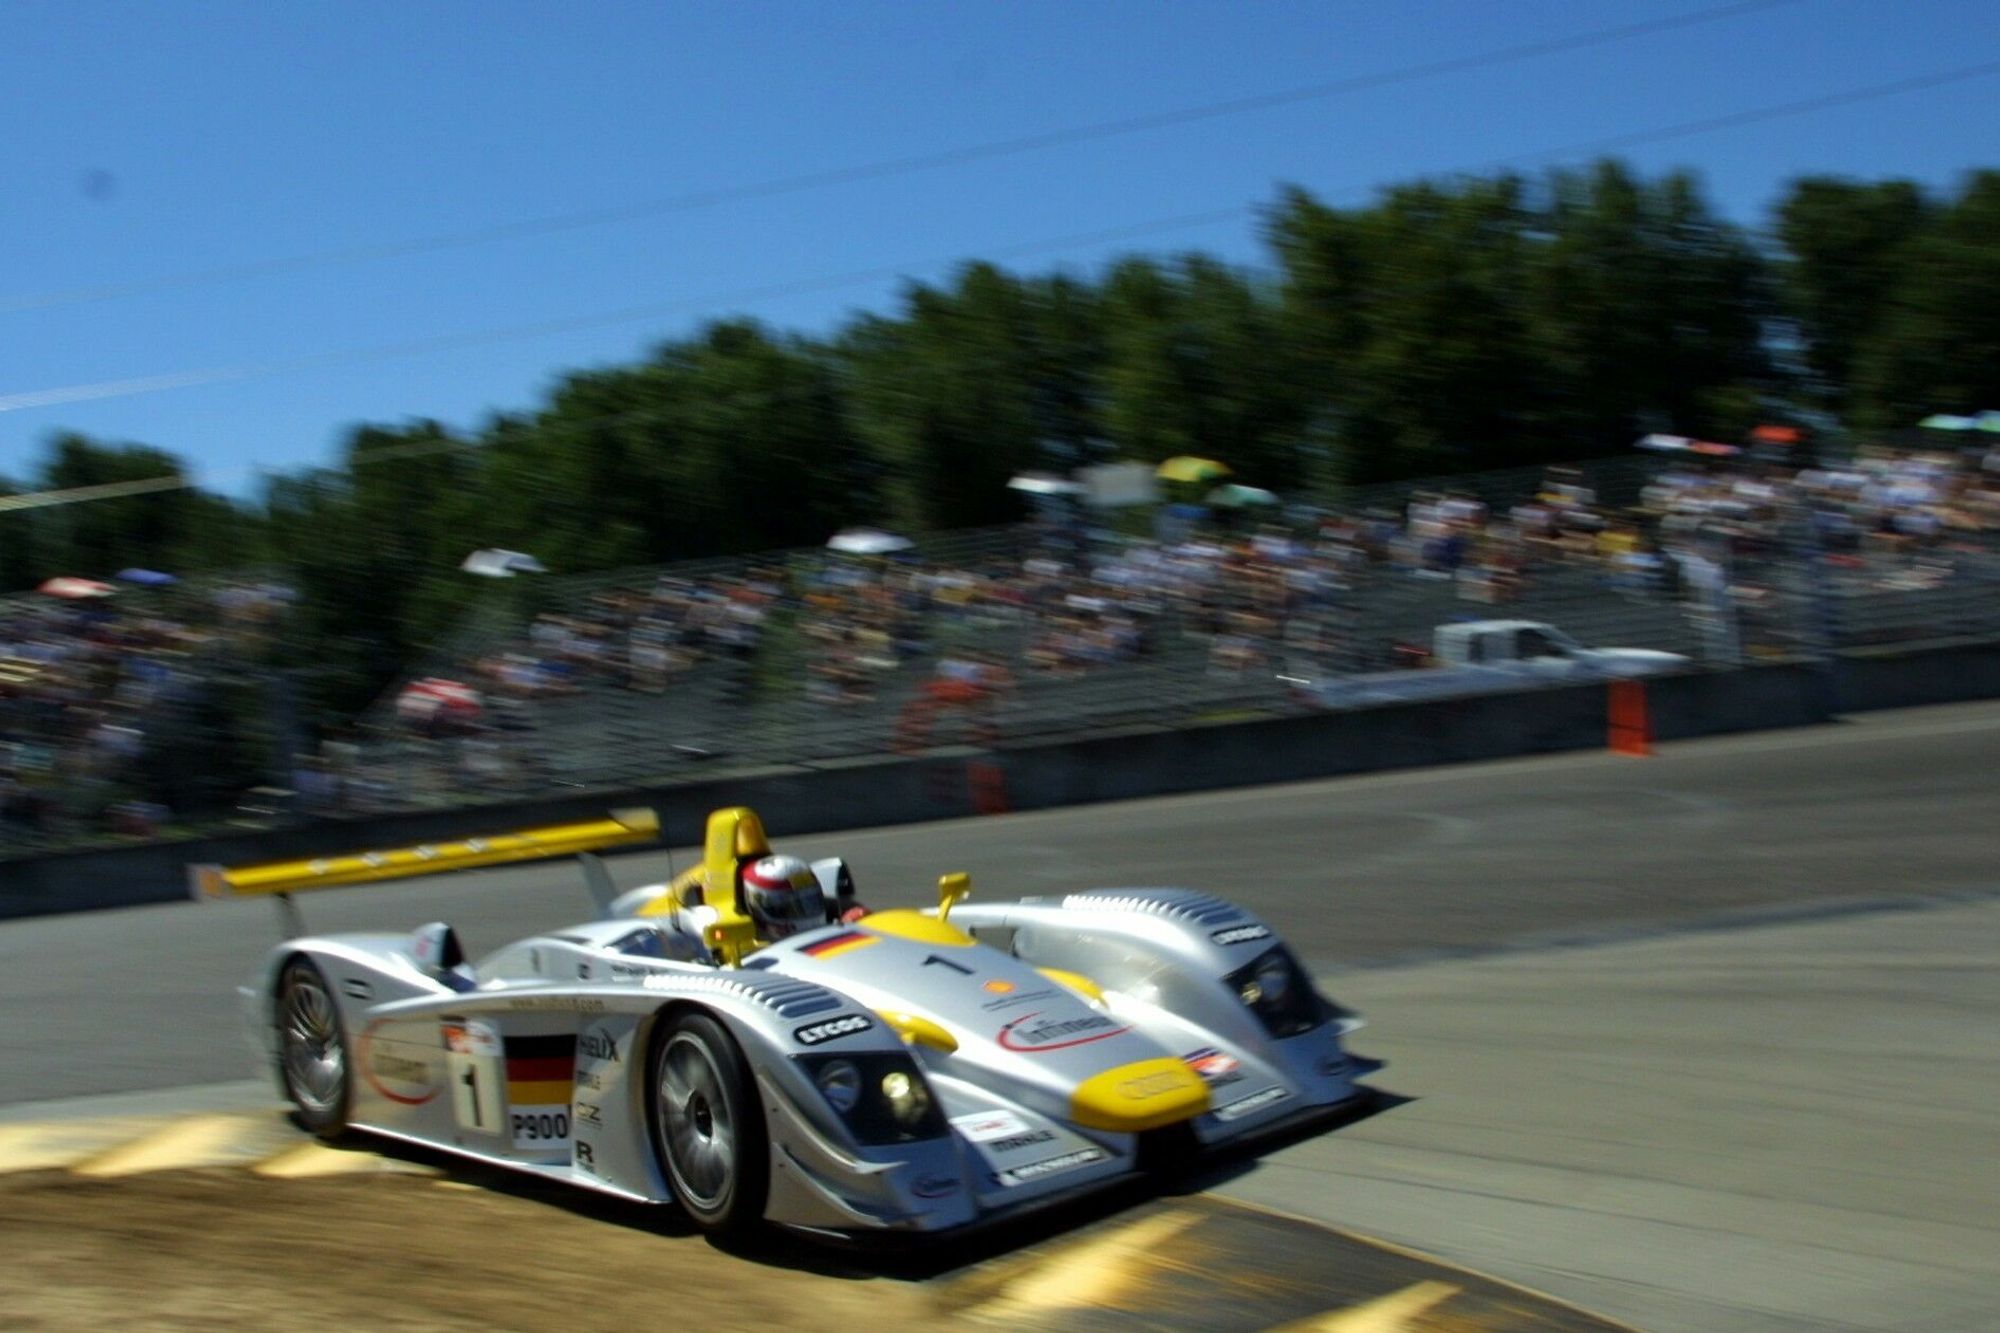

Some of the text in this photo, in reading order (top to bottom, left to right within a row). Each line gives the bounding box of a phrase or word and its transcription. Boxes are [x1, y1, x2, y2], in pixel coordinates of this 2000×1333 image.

[919, 954, 976, 975] 1
[461, 1062, 483, 1128] 1
[512, 1113, 568, 1140] P900
